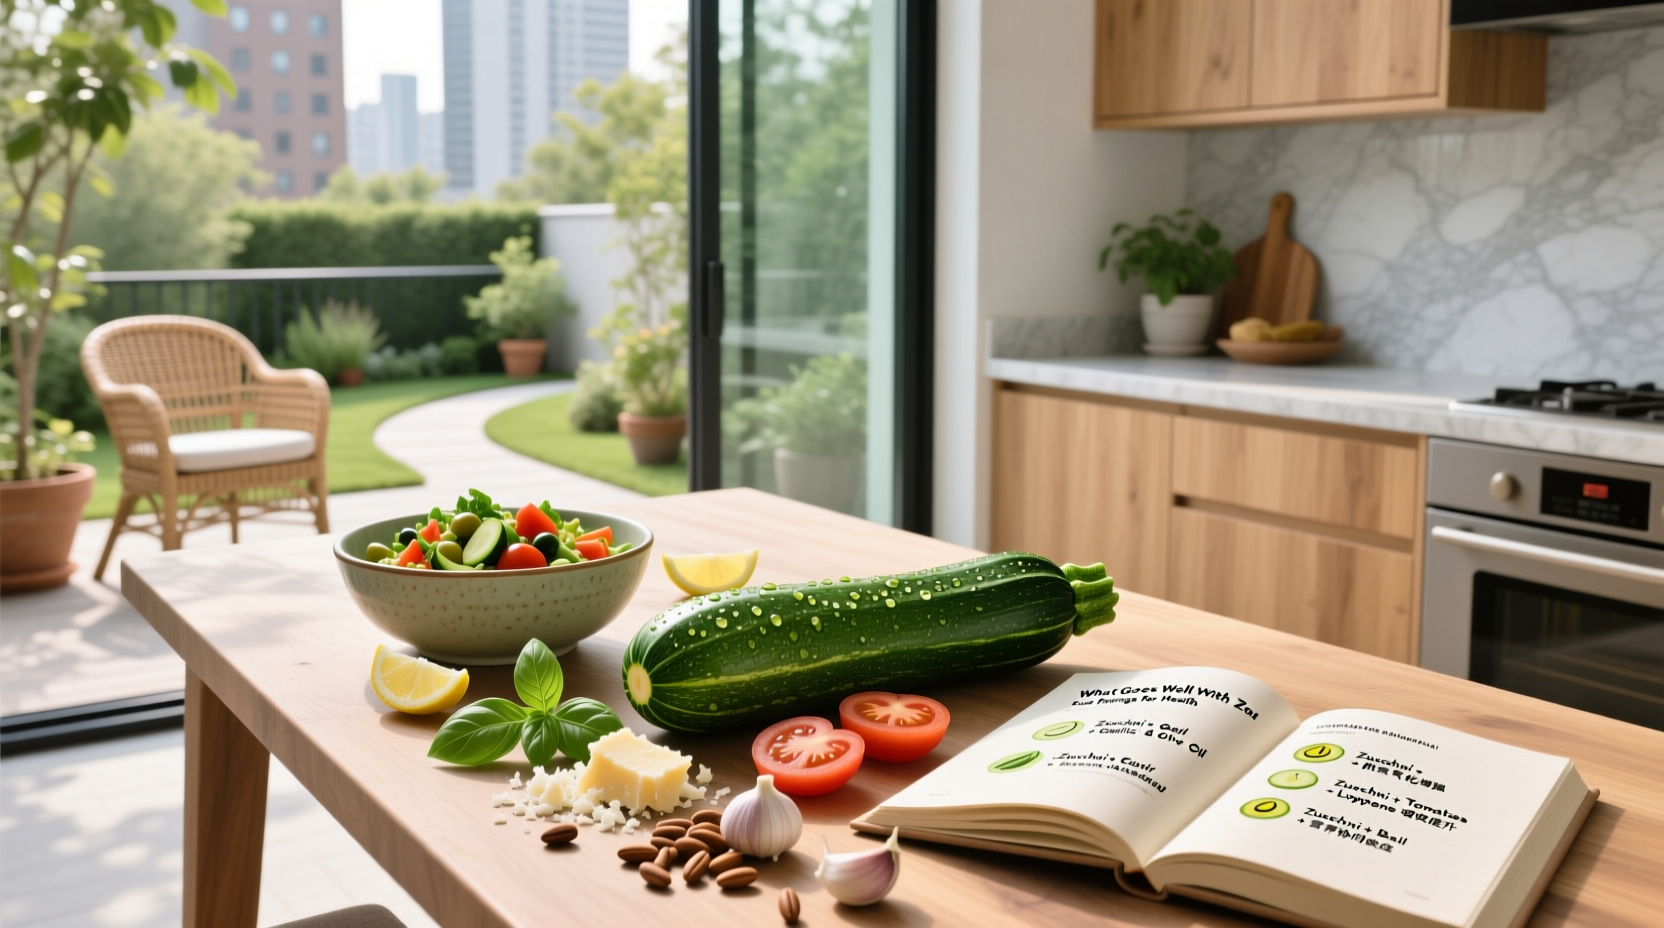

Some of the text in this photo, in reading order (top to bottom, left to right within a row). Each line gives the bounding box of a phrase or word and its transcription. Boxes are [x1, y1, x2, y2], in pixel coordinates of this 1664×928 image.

[1080, 688, 1118, 698] What
[1120, 686, 1158, 695] Goes
[1162, 684, 1195, 695] Well
